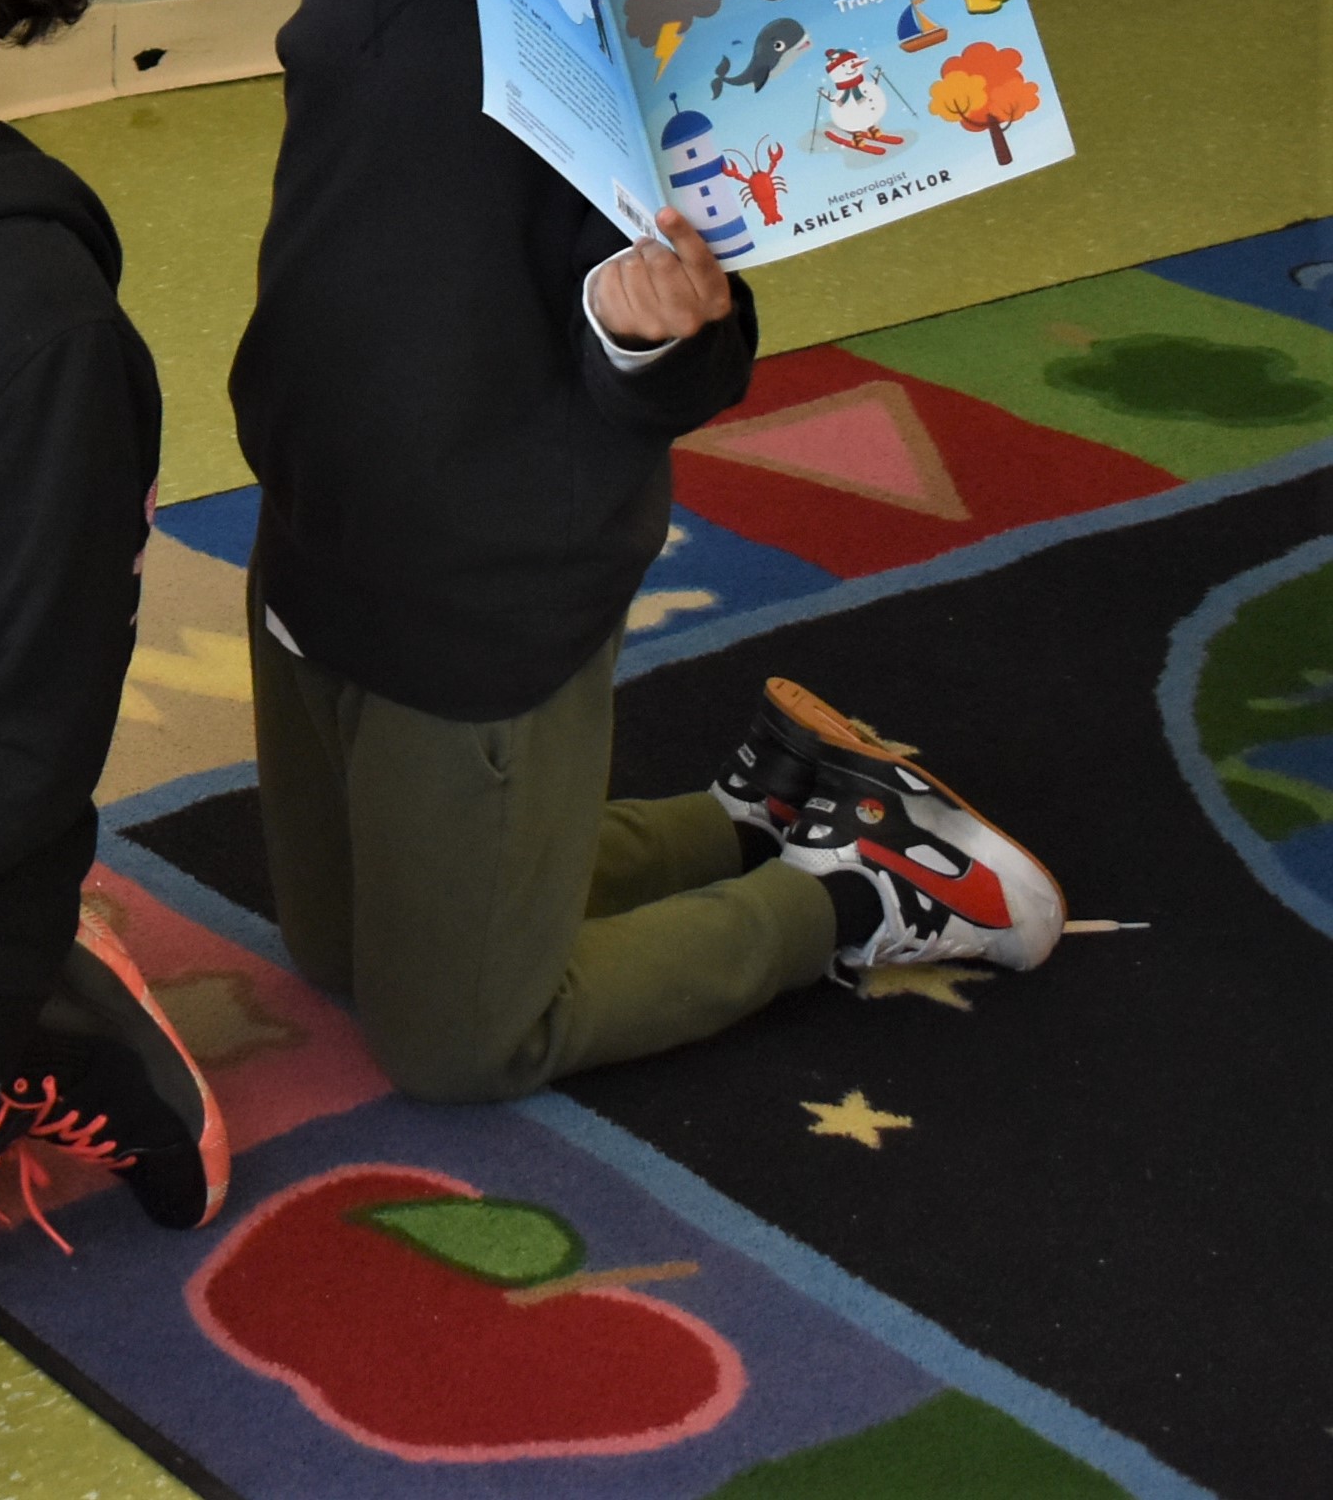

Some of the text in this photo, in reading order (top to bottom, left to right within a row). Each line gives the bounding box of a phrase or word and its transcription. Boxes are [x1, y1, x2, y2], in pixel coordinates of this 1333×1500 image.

[793, 169, 952, 237] ASHLEY BAYLOR
[827, 170, 909, 206] Meteorologist
